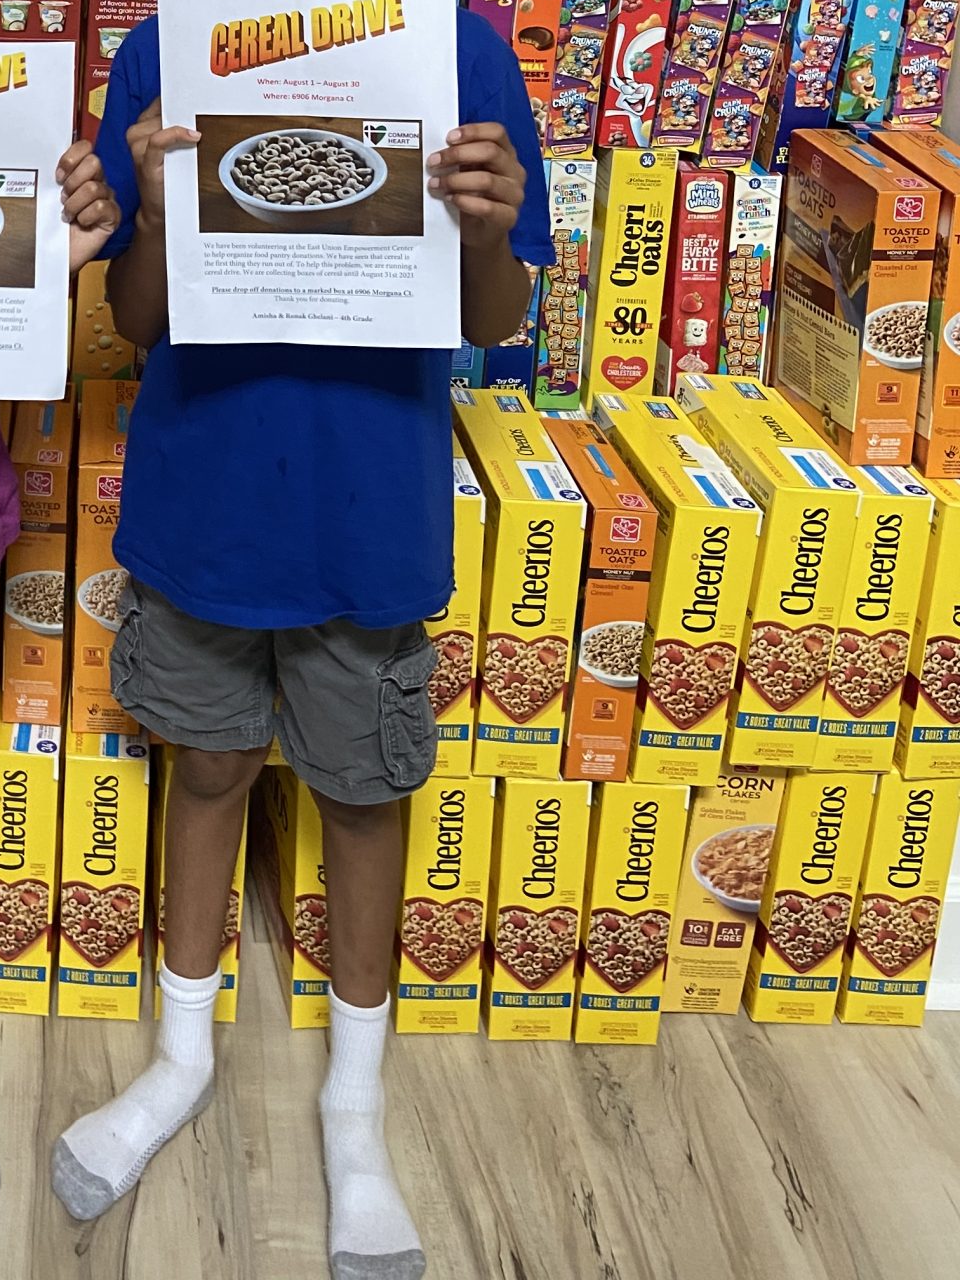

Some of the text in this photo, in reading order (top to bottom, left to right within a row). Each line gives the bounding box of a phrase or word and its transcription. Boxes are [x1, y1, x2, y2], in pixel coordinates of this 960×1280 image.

[210, 10, 308, 77] CEREAL
[257, 78, 281, 86] When:
[283, 79, 308, 88] August
[323, 80, 349, 88] August
[263, 92, 290, 100] Where:
[311, 94, 344, 103] Morgana
[512, 519, 555, 628] Cheerios
[779, 507, 830, 615] Cheerios
[427, 789, 466, 891] Cheerios
[617, 801, 658, 902] Cheerios
[888, 787, 934, 888] Cheerios
